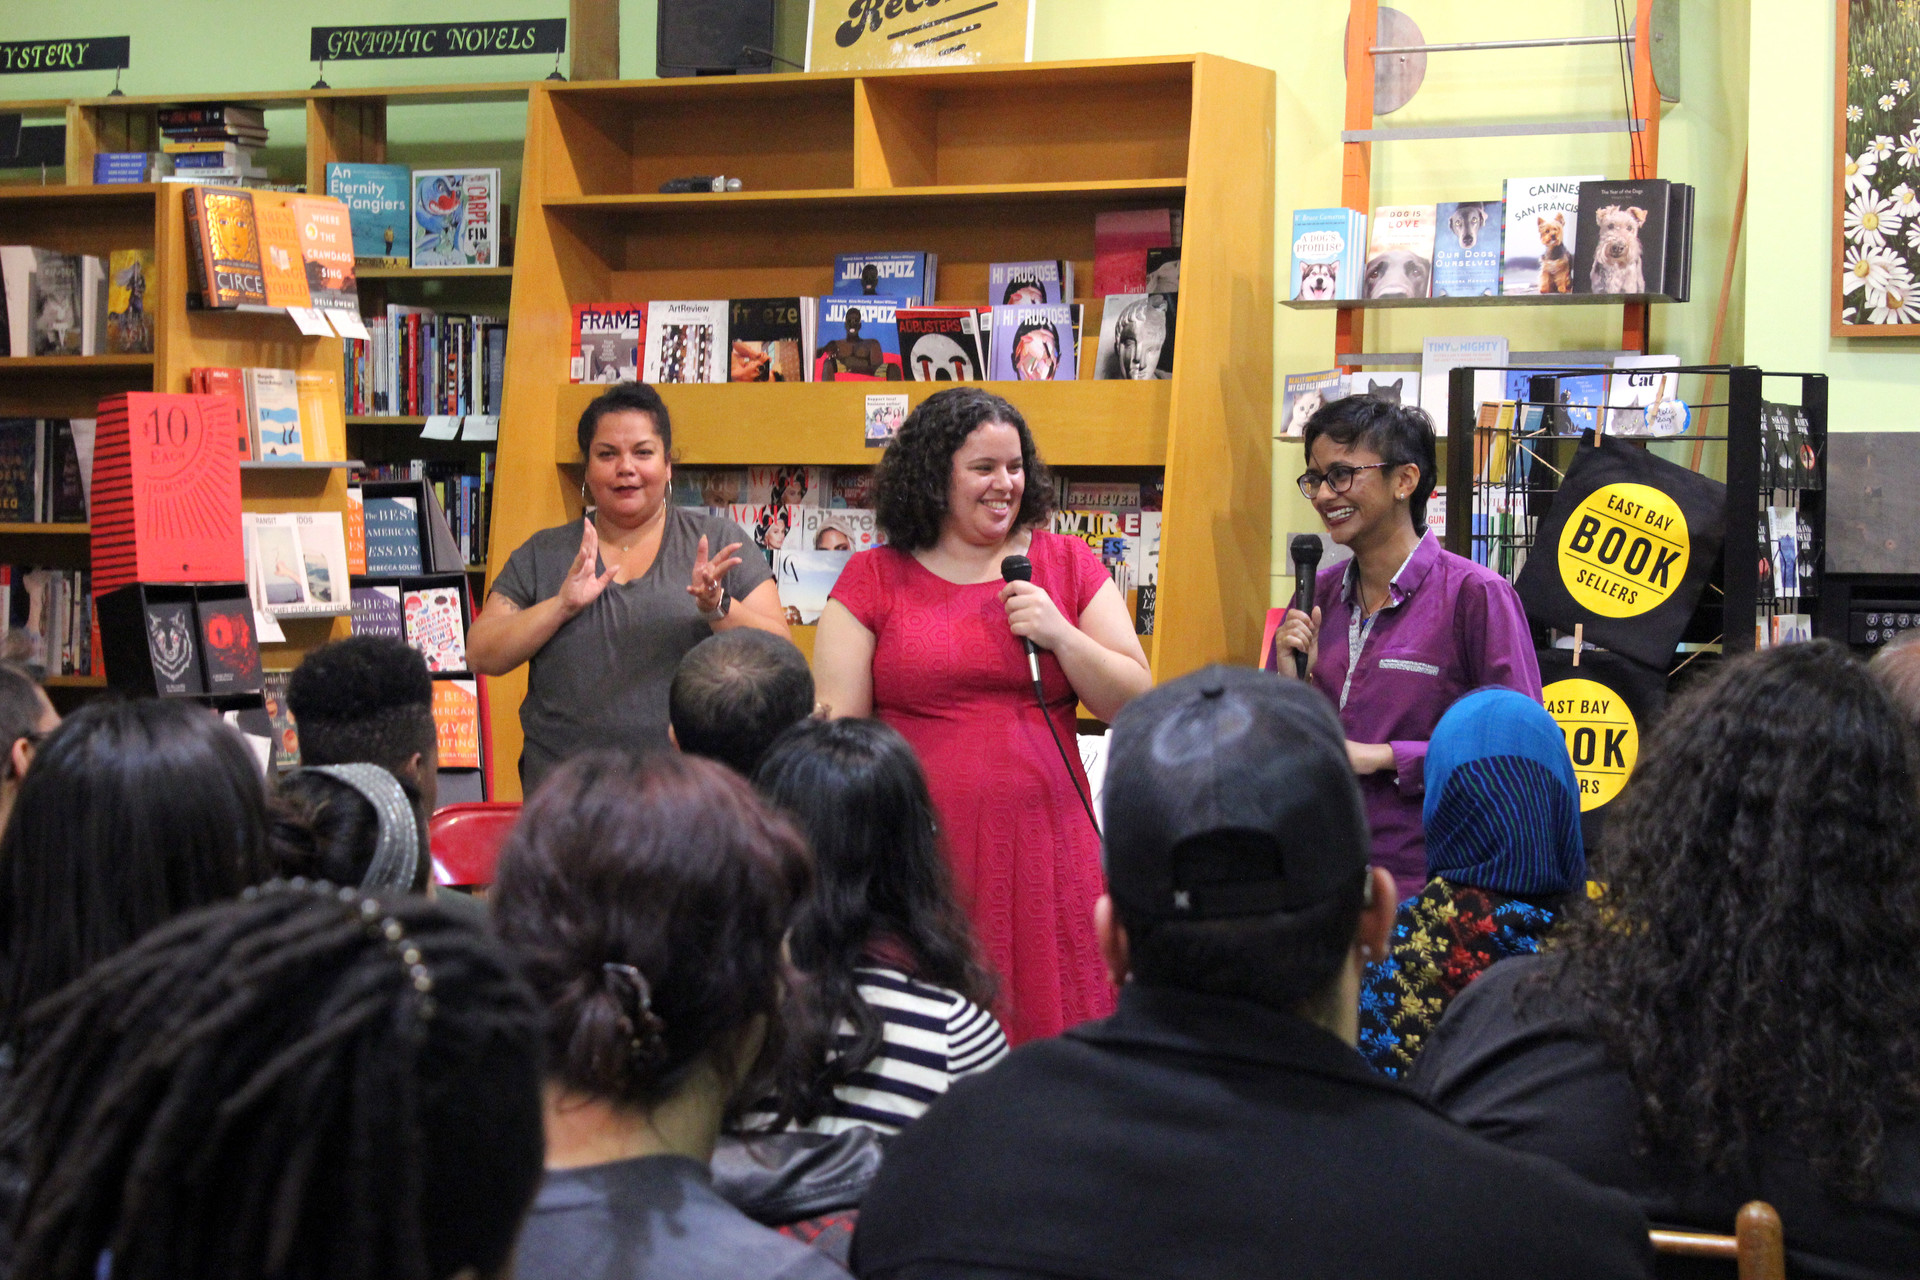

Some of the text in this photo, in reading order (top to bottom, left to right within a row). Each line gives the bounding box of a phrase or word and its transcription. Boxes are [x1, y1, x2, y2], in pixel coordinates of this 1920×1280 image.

[327, 27, 536, 59] GRAPHIC NOVELS
[0, 43, 90, 68] YSTERY
[331, 165, 351, 178] An
[331, 179, 385, 198] Eternity
[1529, 182, 1580, 197] CANINES
[347, 196, 406, 213] Tangiers
[467, 186, 489, 226] CARPE
[1515, 202, 1579, 222] SAN FRANCIS
[312, 213, 341, 226] WHERE
[1388, 220, 1420, 229] LOVE
[320, 231, 337, 243] THE
[468, 227, 488, 241] FIN
[307, 249, 352, 264] CRAWDADS
[321, 267, 342, 280] SING
[992, 264, 1058, 284] HI FRUCTOSE
[217, 272, 263, 294] CIRCE
[1123, 284, 1145, 293] Earth
[668, 303, 710, 314] ArtReview
[732, 303, 799, 325] freze
[1003, 306, 1070, 326] HI FRUCTOSE
[899, 318, 962, 334] ADBUSTERS
[1429, 341, 1498, 352] TINY MIGHTY
[1628, 371, 1655, 388] Cat
[151, 451, 185, 465] EACH
[751, 468, 818, 489] VOGUE
[1068, 491, 1139, 507] BELIEVER
[365, 508, 416, 521] The BEST
[731, 504, 801, 527] VOGUE
[1428, 515, 1445, 524] GUN
[1607, 494, 1674, 531] EAST BAY
[255, 517, 277, 525] RANSIT
[1059, 512, 1140, 533] WIRE
[366, 527, 418, 538] AMERICAN
[368, 545, 419, 558] ESSAYS
[1569, 514, 1681, 589] BOOK
[368, 563, 397, 572] REBECCA
[1143, 588, 1156, 600] Ne
[1576, 569, 1638, 604] SELLERS
[351, 598, 398, 610] he BEST
[1143, 599, 1156, 611] Lif
[352, 611, 399, 622] MERICAN
[444, 690, 473, 702] BEST
[433, 707, 474, 716] ERICAN
[1544, 699, 1610, 714] AST BAY
[439, 719, 474, 735] avel
[438, 738, 476, 748] ITING
[1562, 726, 1628, 768] OK
